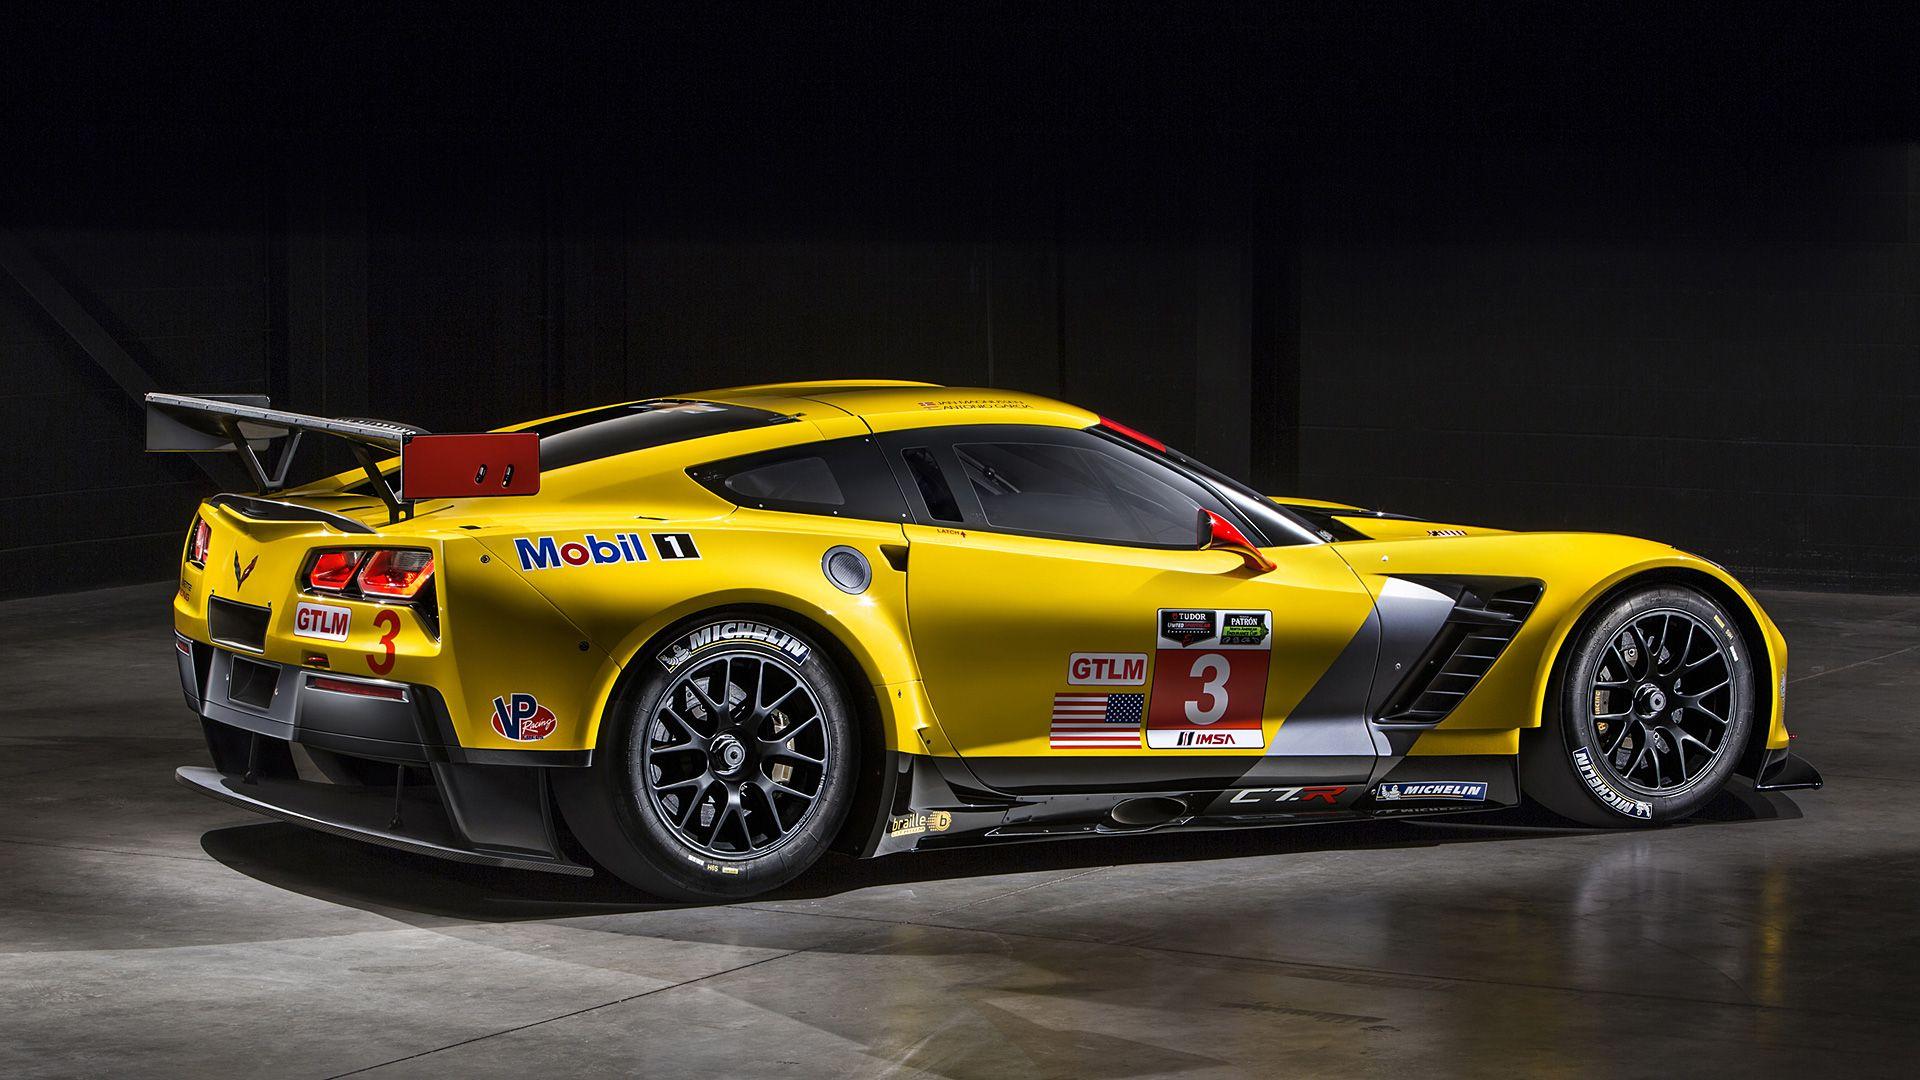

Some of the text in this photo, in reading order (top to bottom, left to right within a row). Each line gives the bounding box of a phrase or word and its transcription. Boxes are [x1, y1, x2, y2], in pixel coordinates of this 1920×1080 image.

[936, 528, 960, 536] LATCH
[514, 533, 647, 571] Mobil
[296, 607, 349, 637] GTLM
[1179, 612, 1207, 621] TUDOR
[1231, 616, 1258, 626] PATRÓN
[365, 609, 401, 676] 3
[689, 622, 809, 658] MICHELIN
[1072, 658, 1145, 680] GTLM
[1184, 653, 1231, 726] 3
[492, 692, 539, 741] VP
[522, 717, 557, 734] Racing
[1195, 733, 1236, 745] IMSA
[1403, 785, 1481, 796] MICHELIN
[1574, 751, 1635, 814] MICHELIN
[892, 812, 927, 832] braille
